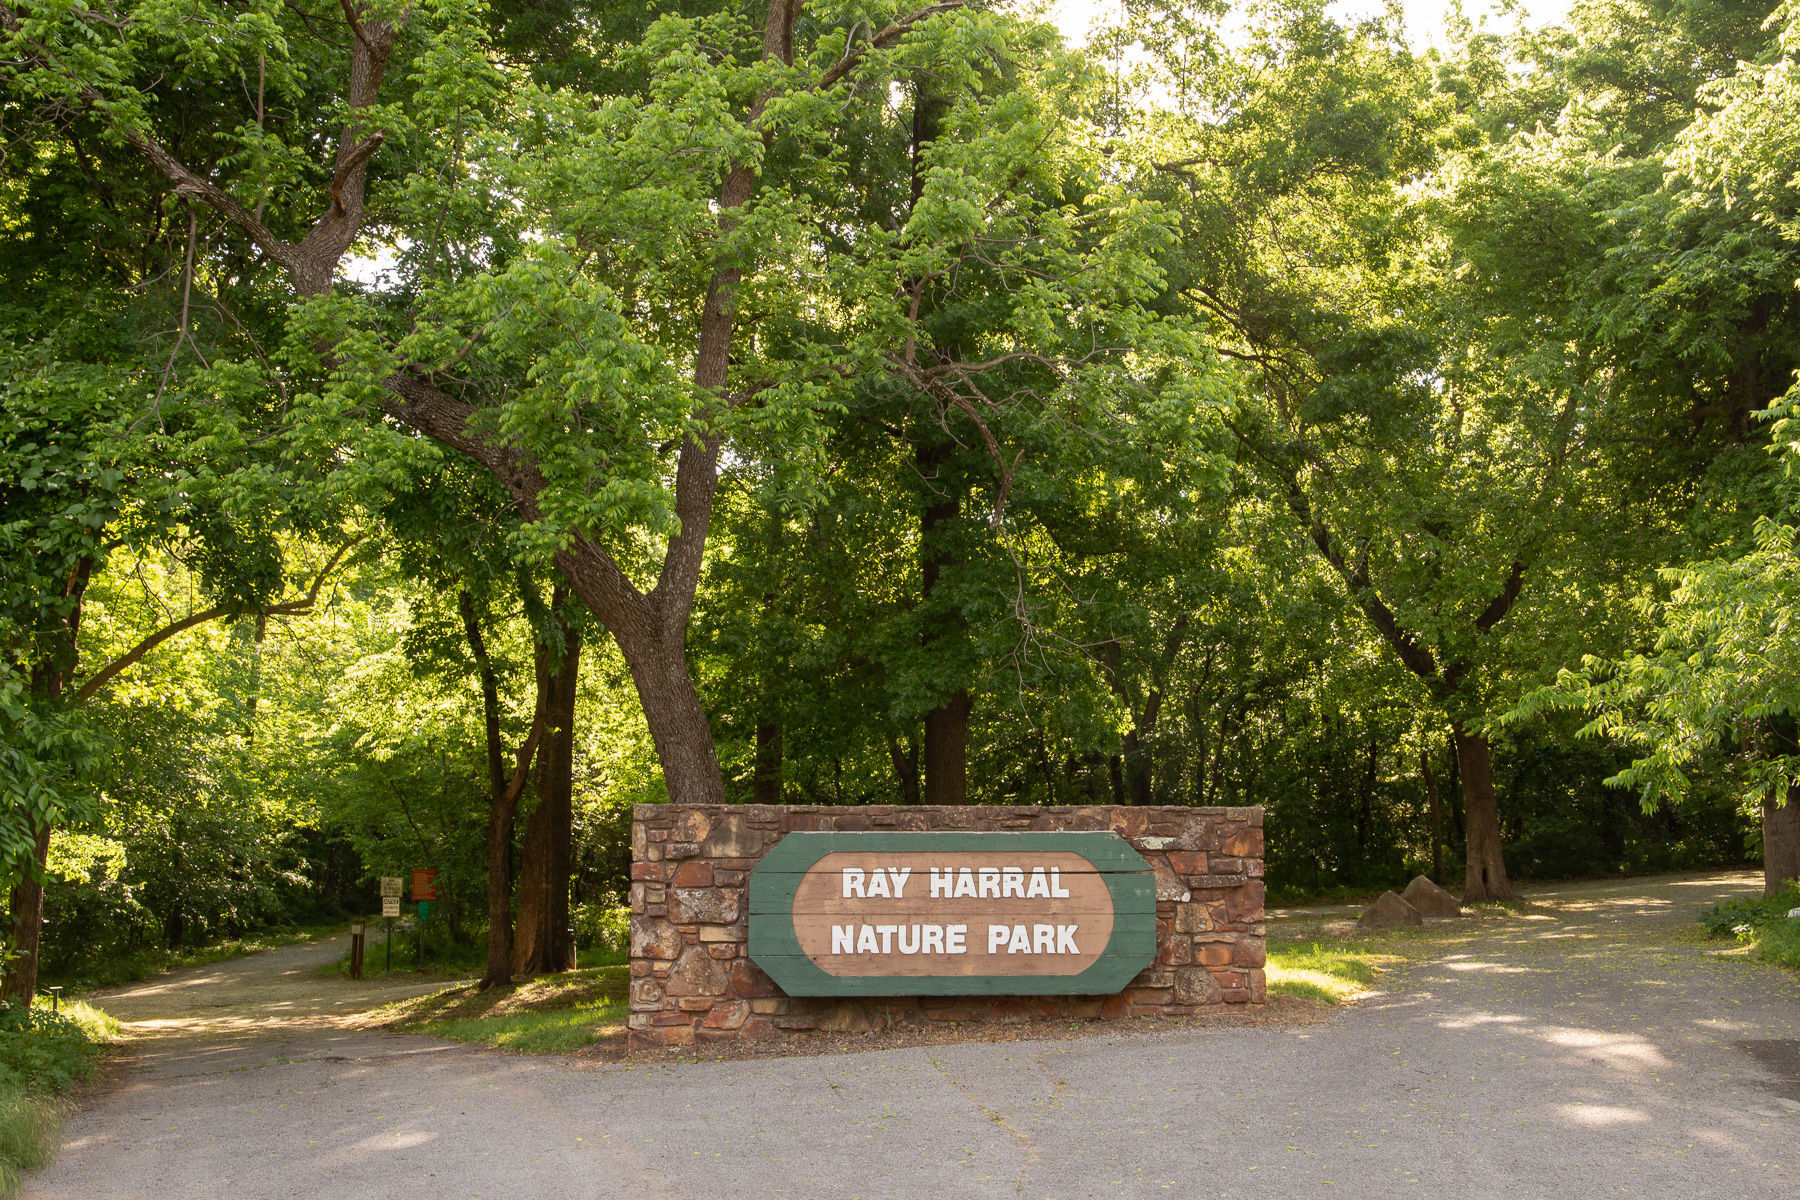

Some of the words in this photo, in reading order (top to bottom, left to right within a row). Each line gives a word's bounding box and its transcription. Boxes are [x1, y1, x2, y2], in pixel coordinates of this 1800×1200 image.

[842, 867, 912, 898] RAY
[930, 866, 1070, 898] HARRAL
[831, 924, 967, 954] NATURE
[988, 924, 1081, 954] PARK
